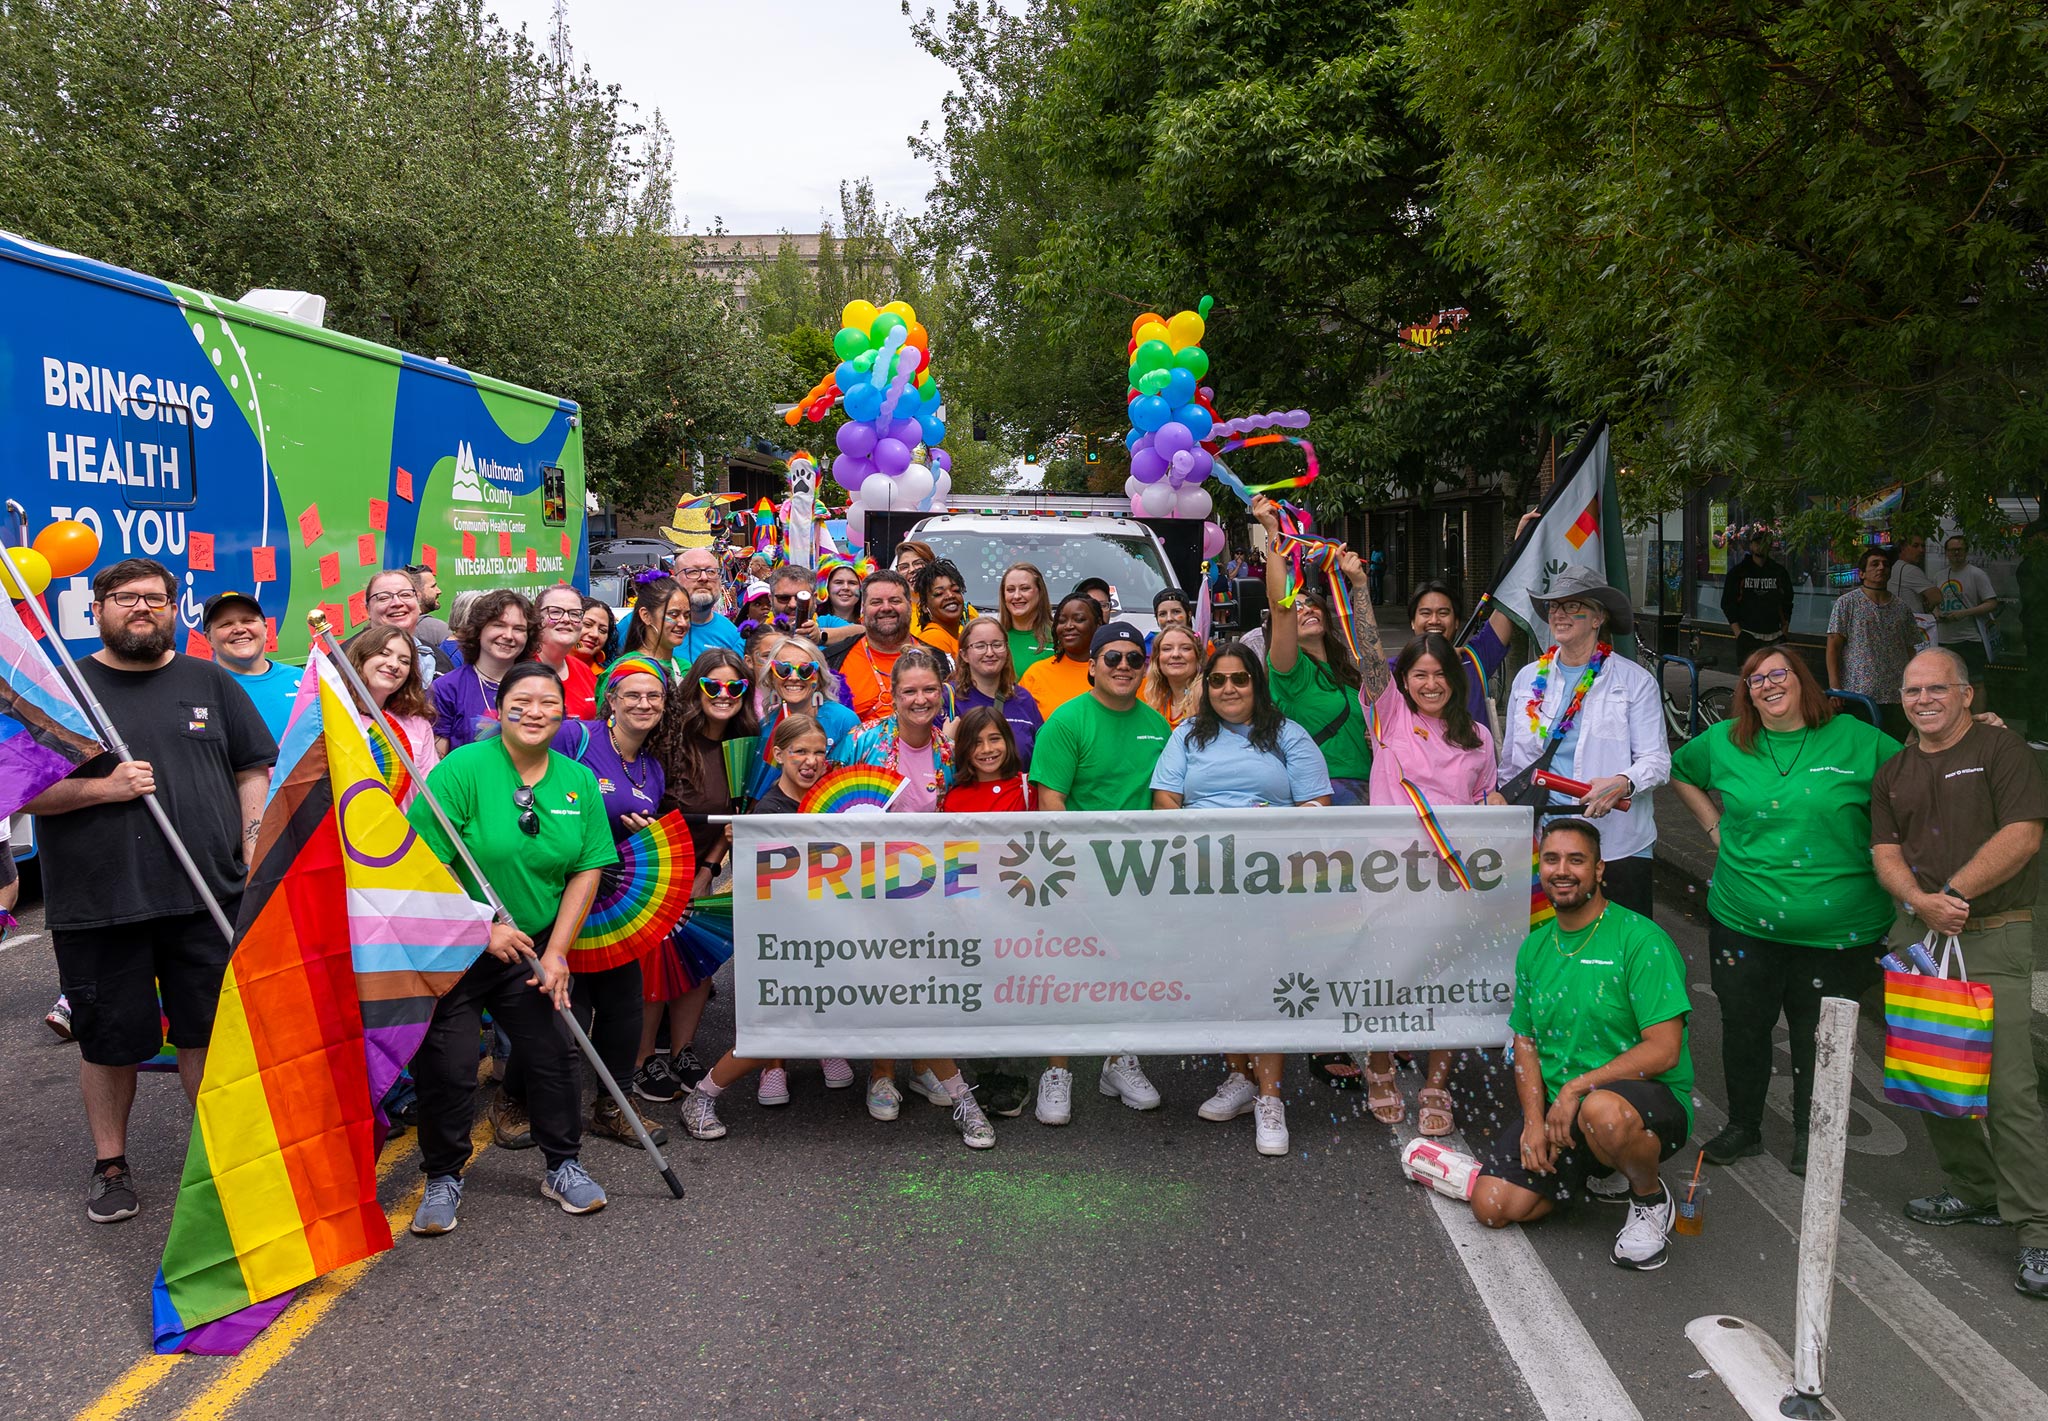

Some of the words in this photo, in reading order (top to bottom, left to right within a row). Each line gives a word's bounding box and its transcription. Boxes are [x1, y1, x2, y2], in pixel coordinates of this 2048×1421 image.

[43, 356, 214, 429] BRINGING
[48, 431, 180, 489] HEALTH
[478, 457, 524, 482] Multnomah
[483, 483, 513, 510] County
[1712, 506, 1724, 516] FOR
[112, 509, 186, 556] YOU
[453, 516, 489, 535] Community
[489, 518, 509, 532] Health
[508, 519, 526, 532] Center
[455, 557, 505, 576] INTEGRATED.
[506, 556, 564, 574] COMPSIONATE.
[1744, 578, 1760, 589] NEW
[1761, 578, 1777, 589] YORK
[756, 840, 981, 900] PRIDE
[1088, 833, 1504, 897] Willamette
[757, 930, 982, 968] Empowering
[993, 928, 1106, 959] voices.
[758, 975, 983, 1013] Empowering
[993, 974, 1192, 1005] differences.
[1326, 977, 1512, 1008] Willamette
[1342, 1007, 1436, 1034] Dental
